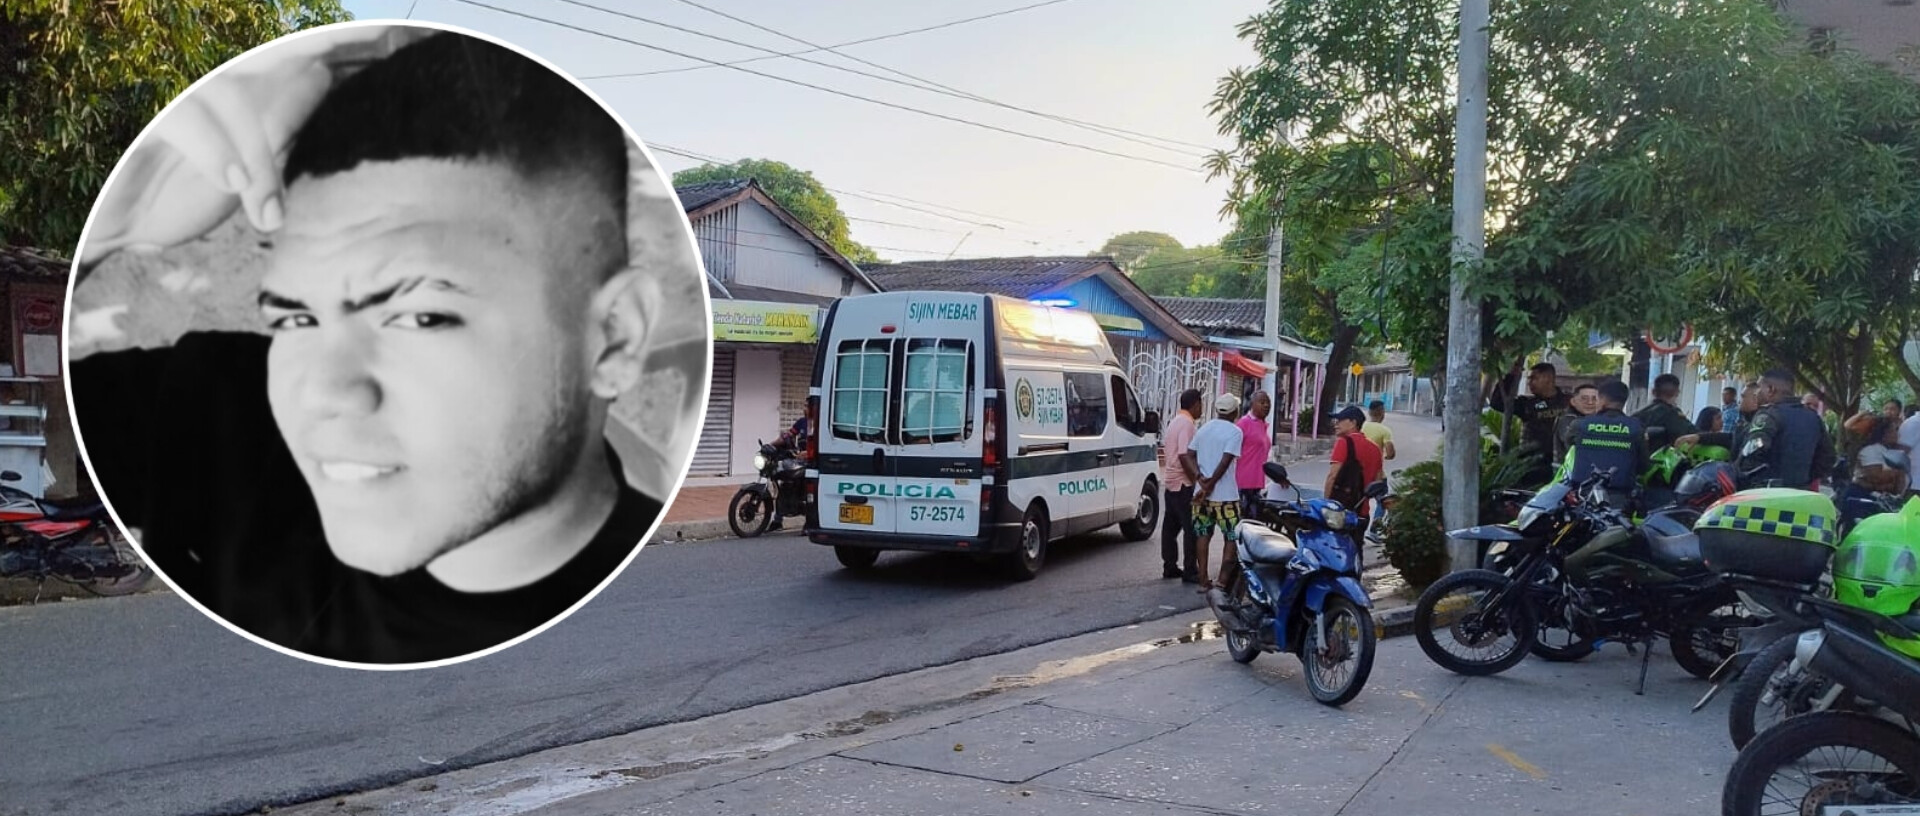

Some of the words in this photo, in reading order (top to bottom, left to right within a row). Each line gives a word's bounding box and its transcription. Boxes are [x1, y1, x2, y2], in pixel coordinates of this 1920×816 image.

[909, 303, 935, 323] SIJIN
[938, 303, 977, 320] MEBAR
[837, 482, 956, 499] POLICÍA
[1058, 475, 1107, 496] POLICÍA
[910, 506, 965, 521] 57-2574
